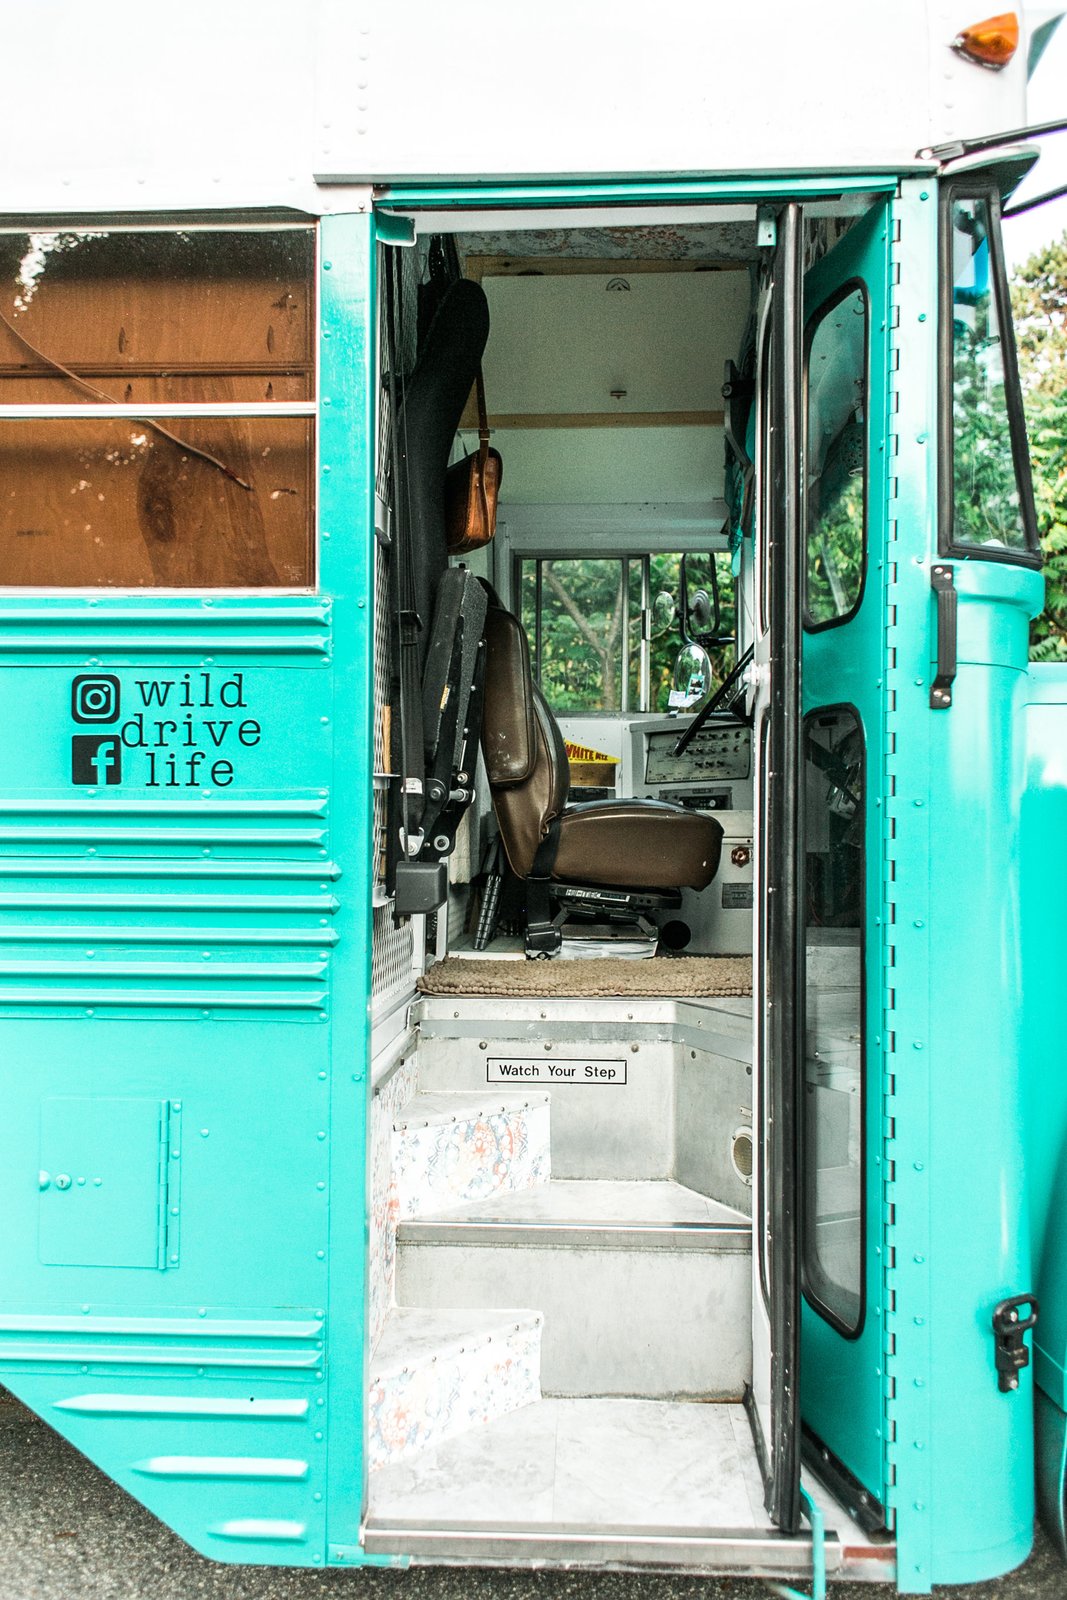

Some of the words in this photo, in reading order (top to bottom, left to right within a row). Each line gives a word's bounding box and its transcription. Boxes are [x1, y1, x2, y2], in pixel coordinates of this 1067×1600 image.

[135, 673, 248, 708] wild
[121, 713, 261, 748] drive
[146, 751, 234, 787] life
[499, 1064, 540, 1076] Watch
[547, 1065, 577, 1077] Your
[584, 1065, 616, 1080] Step
